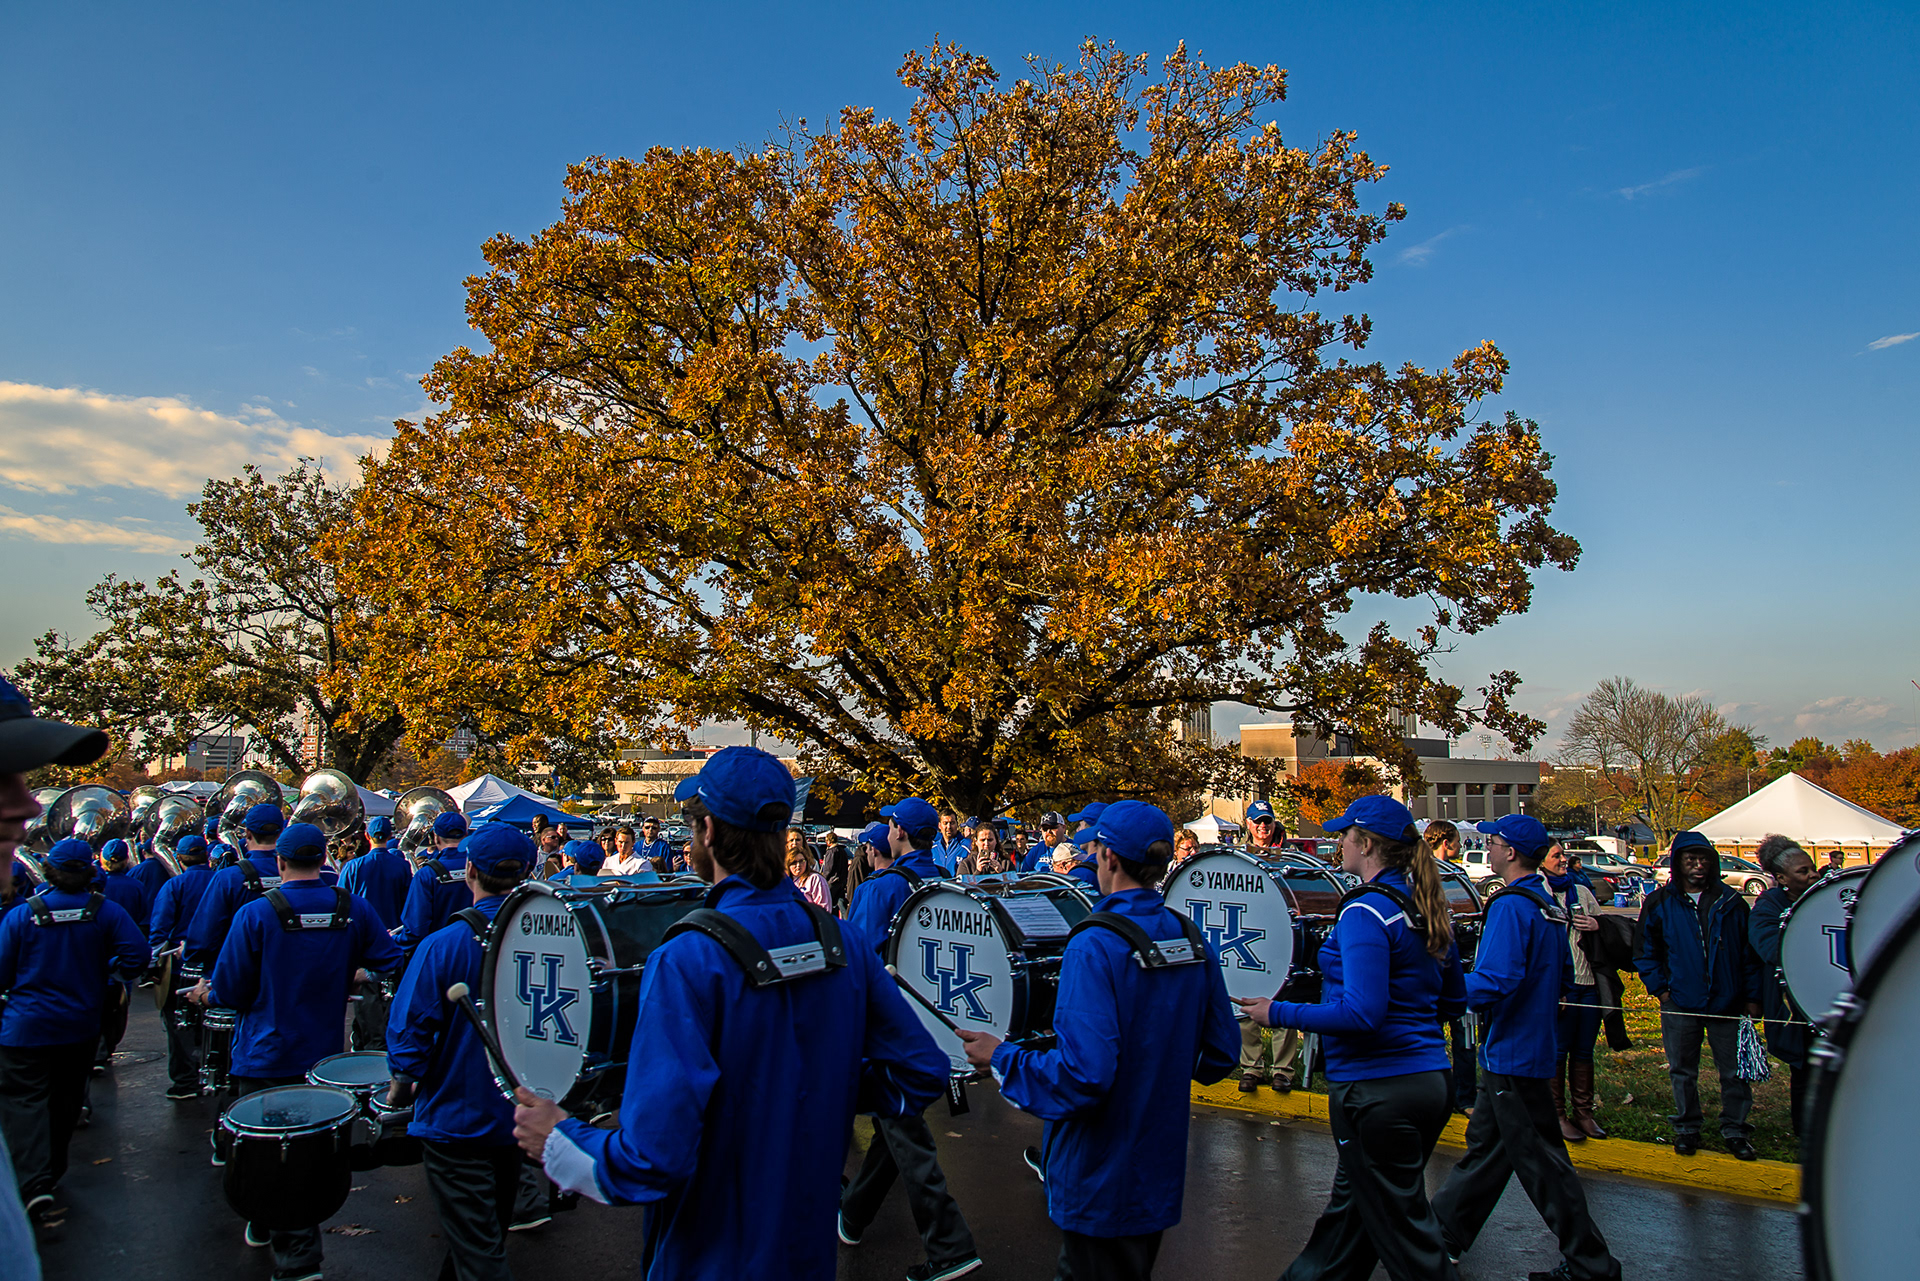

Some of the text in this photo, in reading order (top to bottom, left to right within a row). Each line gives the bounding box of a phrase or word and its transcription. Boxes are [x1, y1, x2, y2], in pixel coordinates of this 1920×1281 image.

[1207, 871, 1265, 893] YAMAHA
[533, 913, 575, 937] YAMAHA
[934, 907, 993, 937] YAMAHA
[918, 937, 992, 1024] UK
[513, 951, 579, 1047] UK
